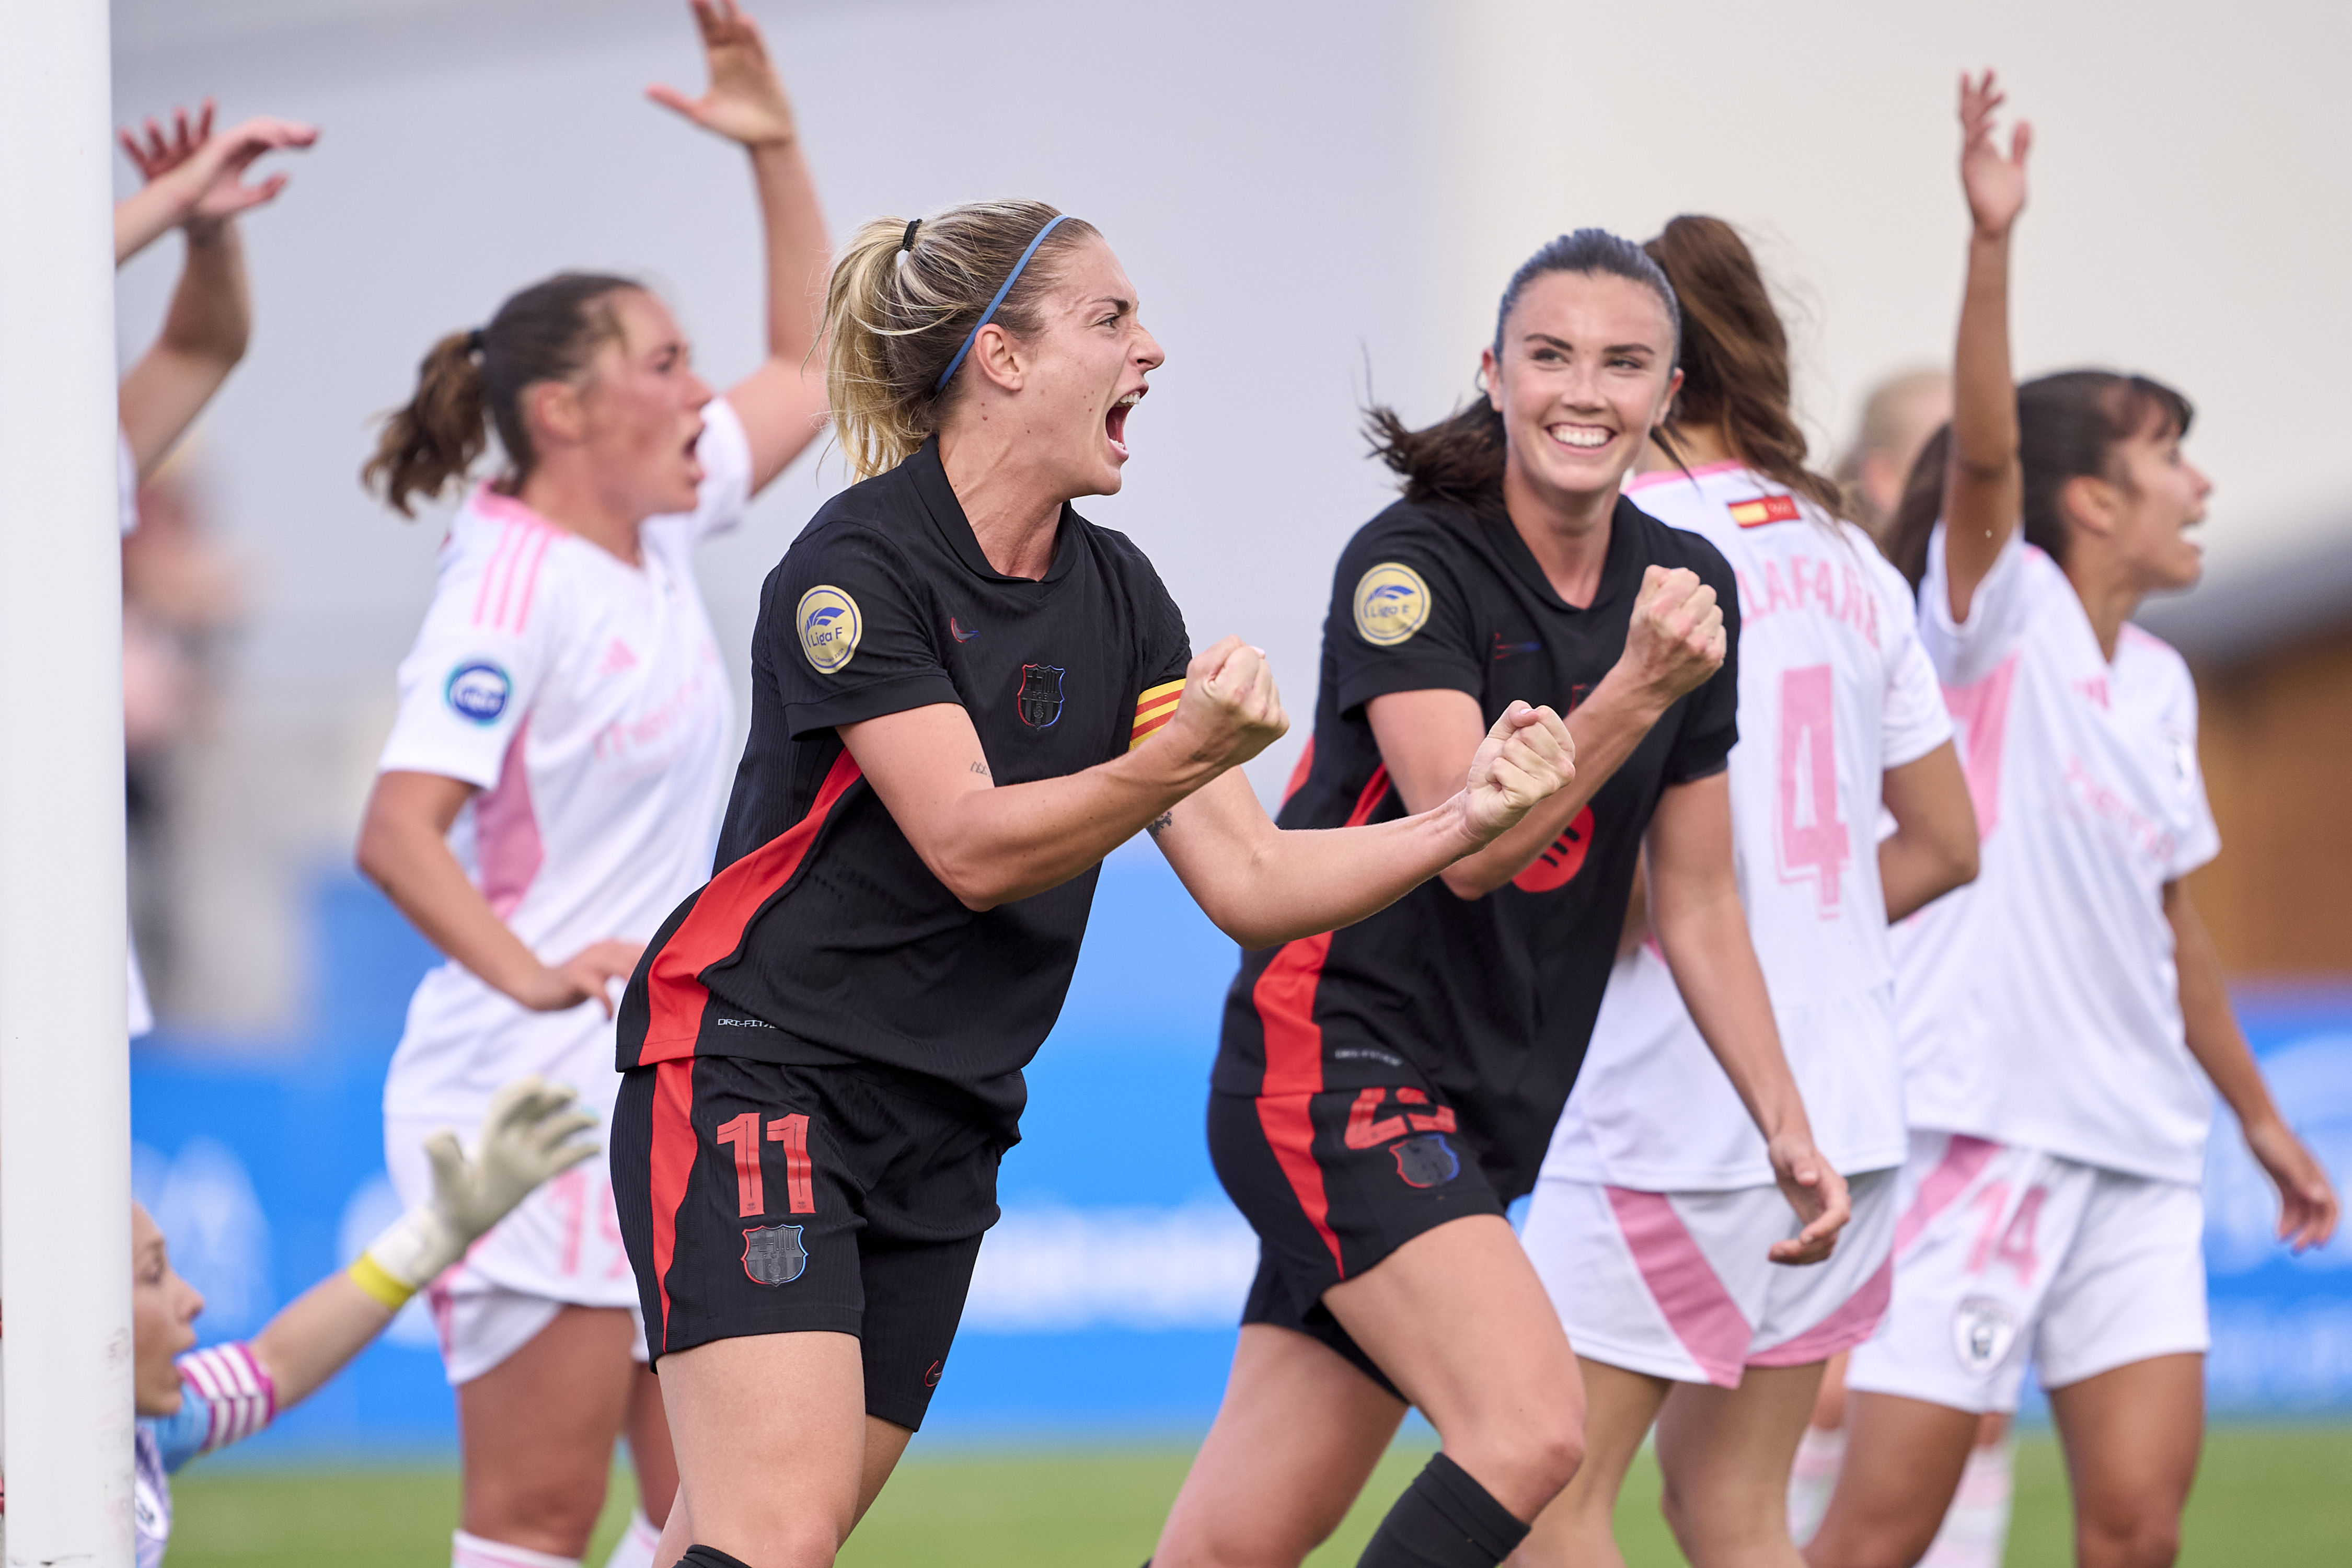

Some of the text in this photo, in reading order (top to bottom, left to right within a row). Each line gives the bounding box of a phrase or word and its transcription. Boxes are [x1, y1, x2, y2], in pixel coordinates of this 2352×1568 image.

[811, 627, 843, 647] Liga F
[1032, 691, 1048, 700] FCB
[1777, 663, 1851, 918] 4
[717, 1113, 816, 1218] 11
[1966, 1179, 2046, 1290] 14
